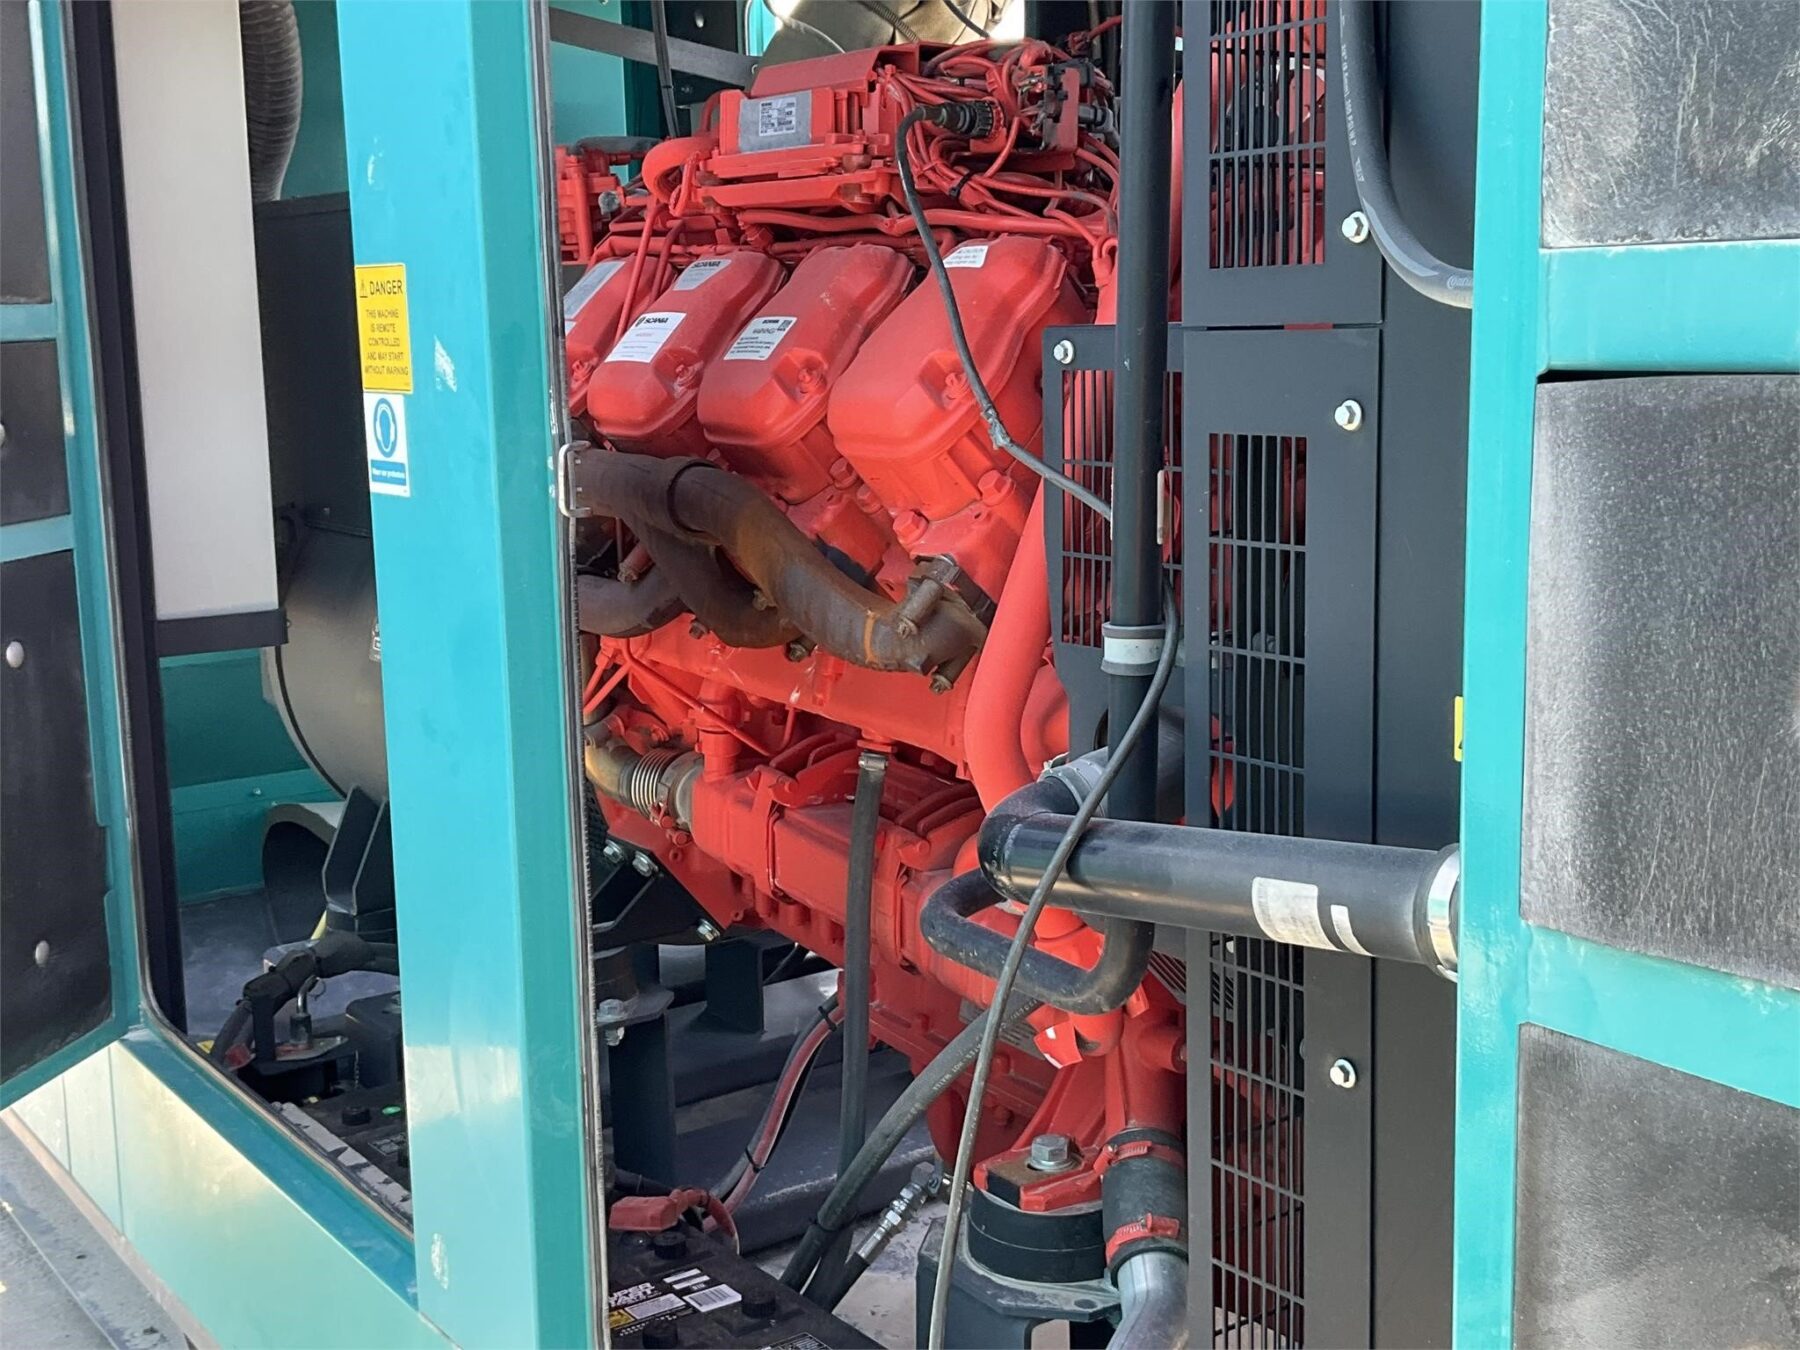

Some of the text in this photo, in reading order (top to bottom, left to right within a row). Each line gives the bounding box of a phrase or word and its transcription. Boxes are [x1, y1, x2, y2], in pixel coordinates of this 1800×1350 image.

[690, 260, 721, 268] SCANIA
[370, 280, 403, 295] DANGER
[366, 309, 399, 319] THIS MACHINE
[370, 323, 396, 333] IS REMOTE
[368, 337, 400, 347] CONTROLLED
[366, 351, 404, 361] AND MAY START
[364, 366, 409, 376] WITHOUT WARNING
